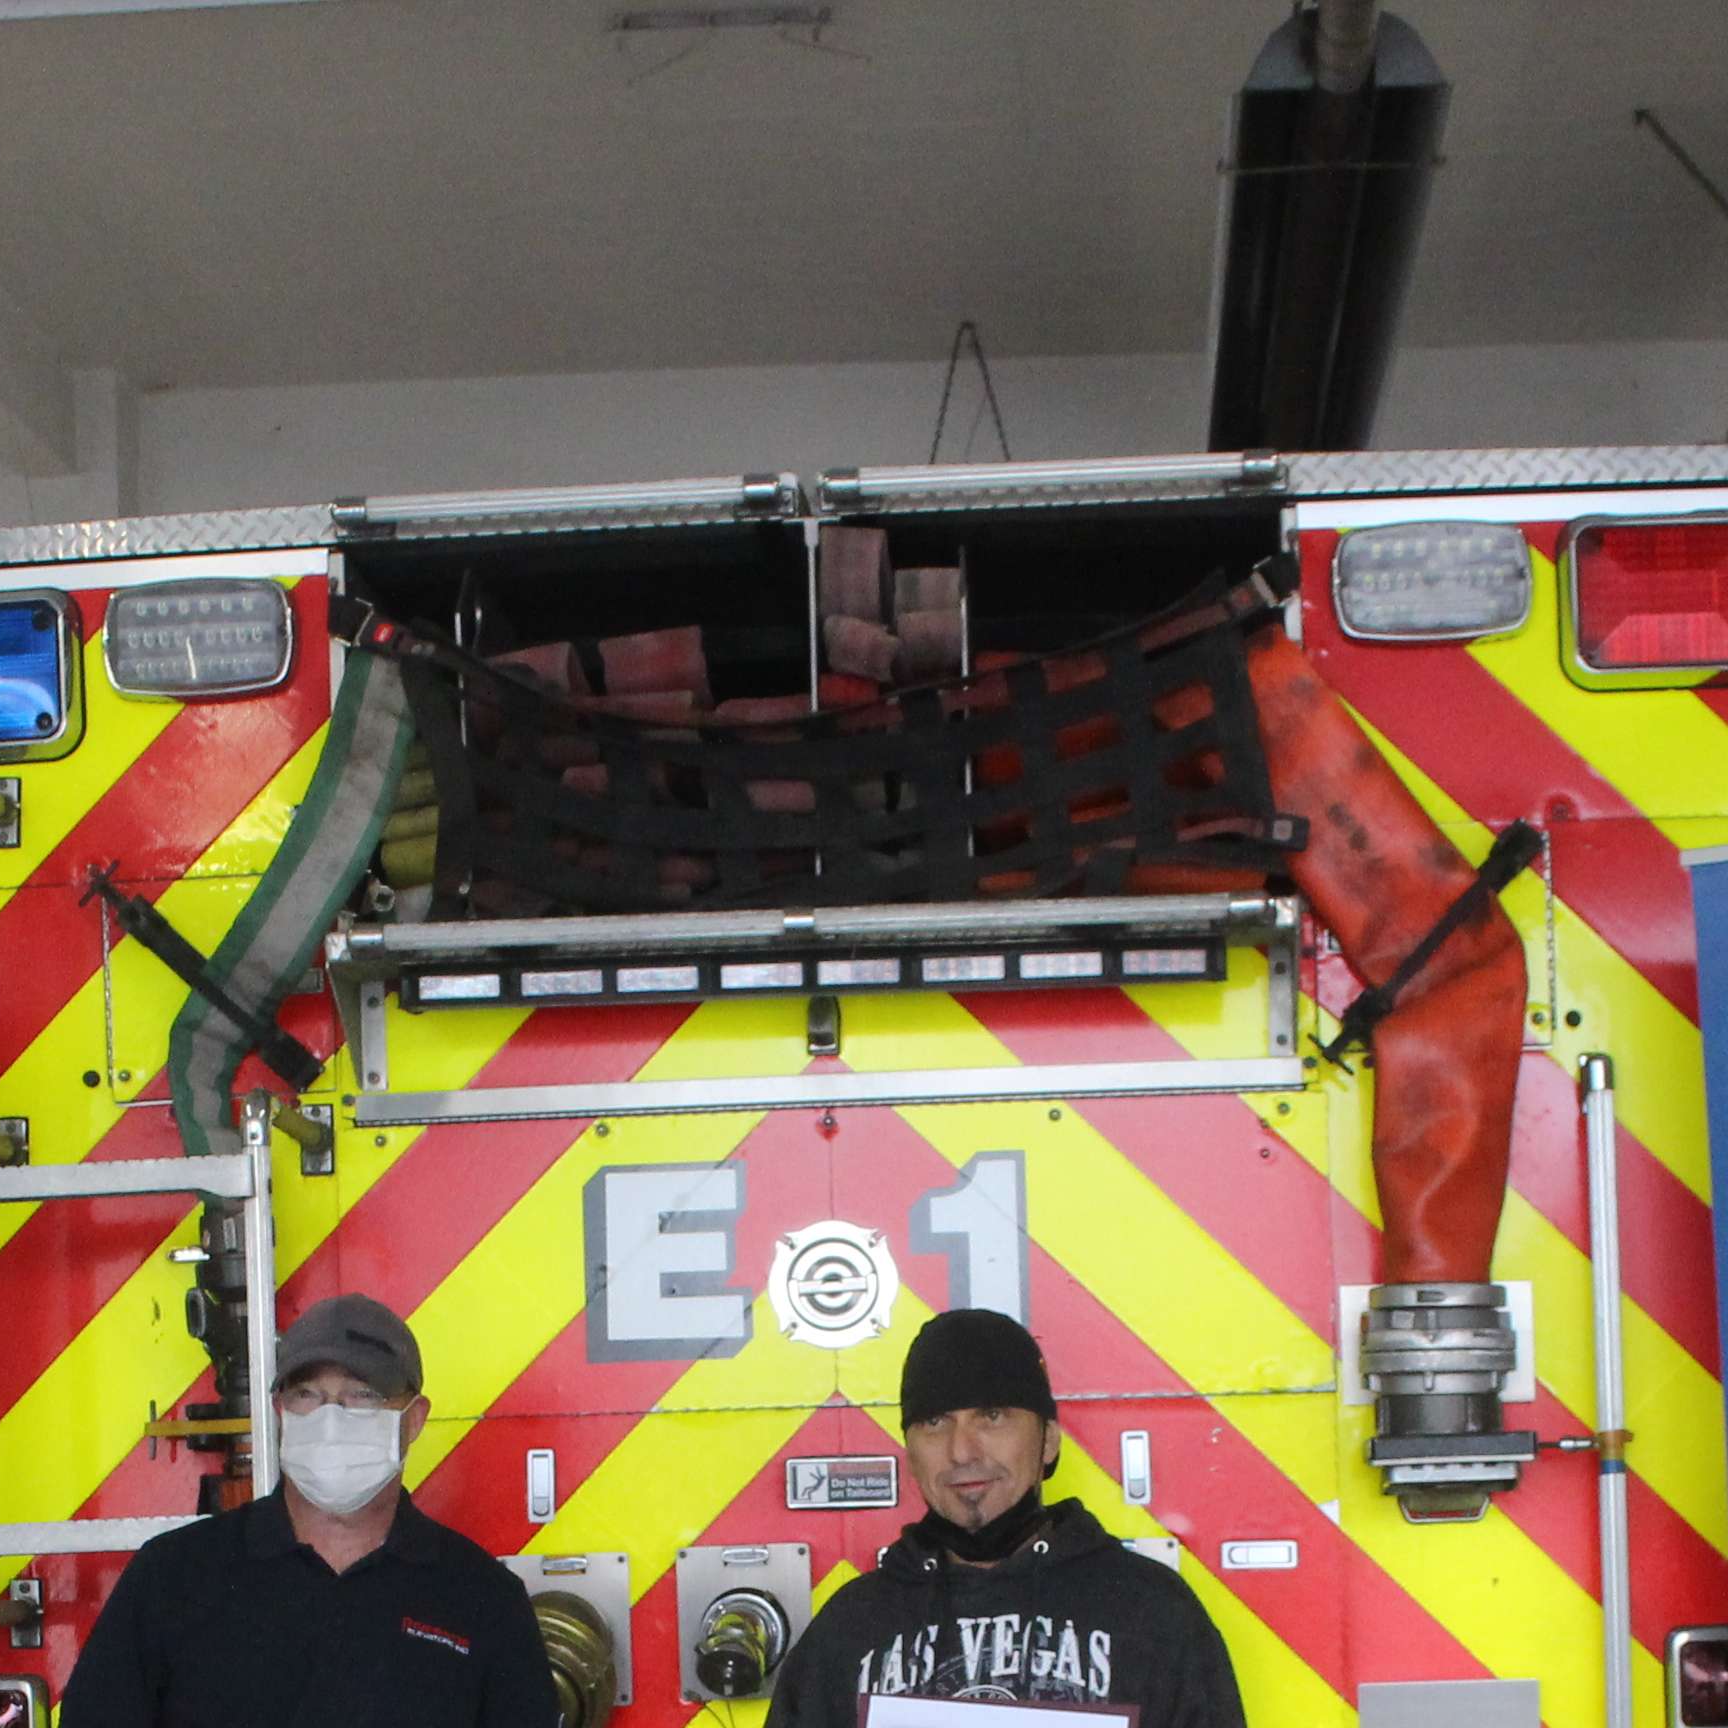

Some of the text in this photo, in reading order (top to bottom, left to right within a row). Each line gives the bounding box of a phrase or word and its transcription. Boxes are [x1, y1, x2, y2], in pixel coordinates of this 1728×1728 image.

[598, 1155, 1024, 1346] E 1
[856, 1614, 1112, 1697] LAS VEGAS
